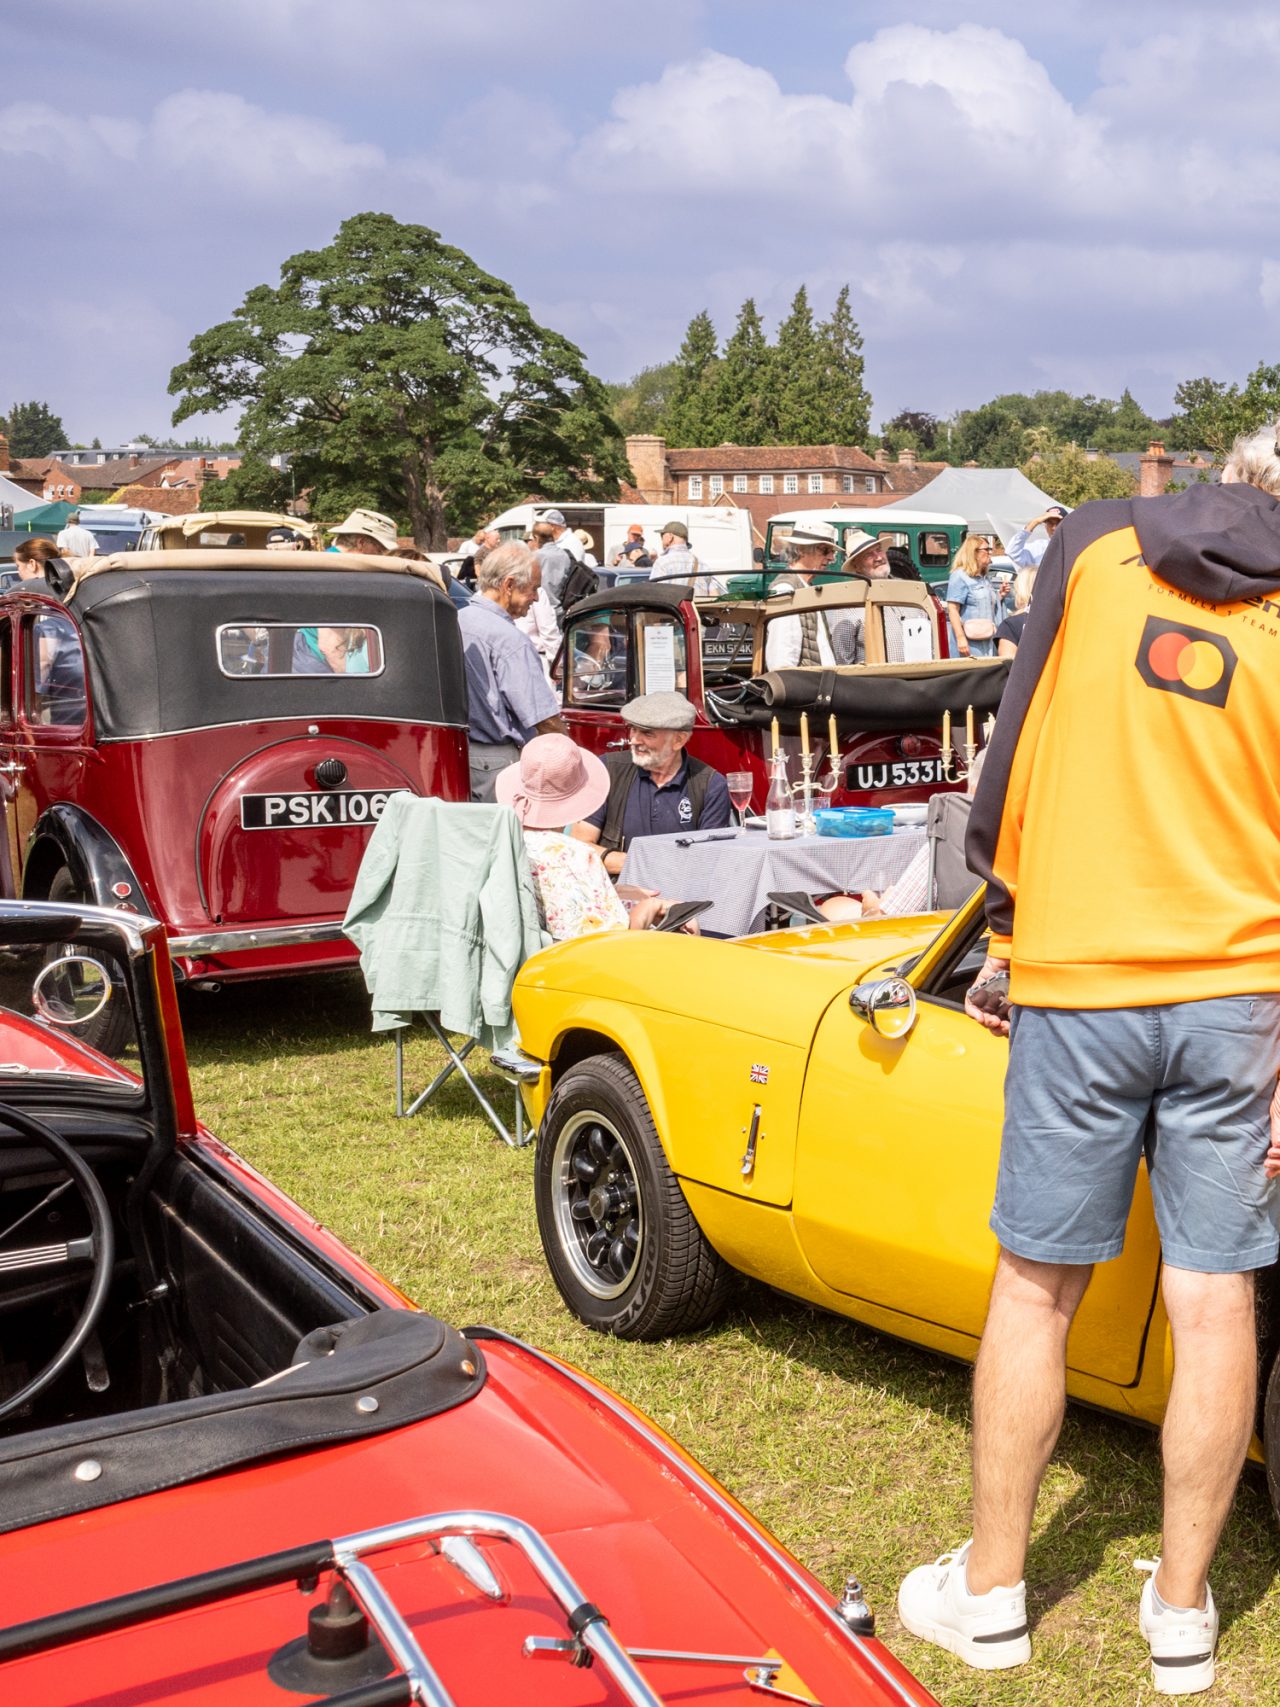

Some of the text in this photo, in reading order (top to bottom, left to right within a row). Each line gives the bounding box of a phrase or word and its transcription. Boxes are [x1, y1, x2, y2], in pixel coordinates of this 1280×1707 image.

[1148, 583, 1217, 612] FORMULA
[1241, 615, 1278, 637] TEAM
[706, 644, 725, 653] EKN
[858, 760, 943, 789] UJ 5331
[265, 793, 388, 825] PSK 106
